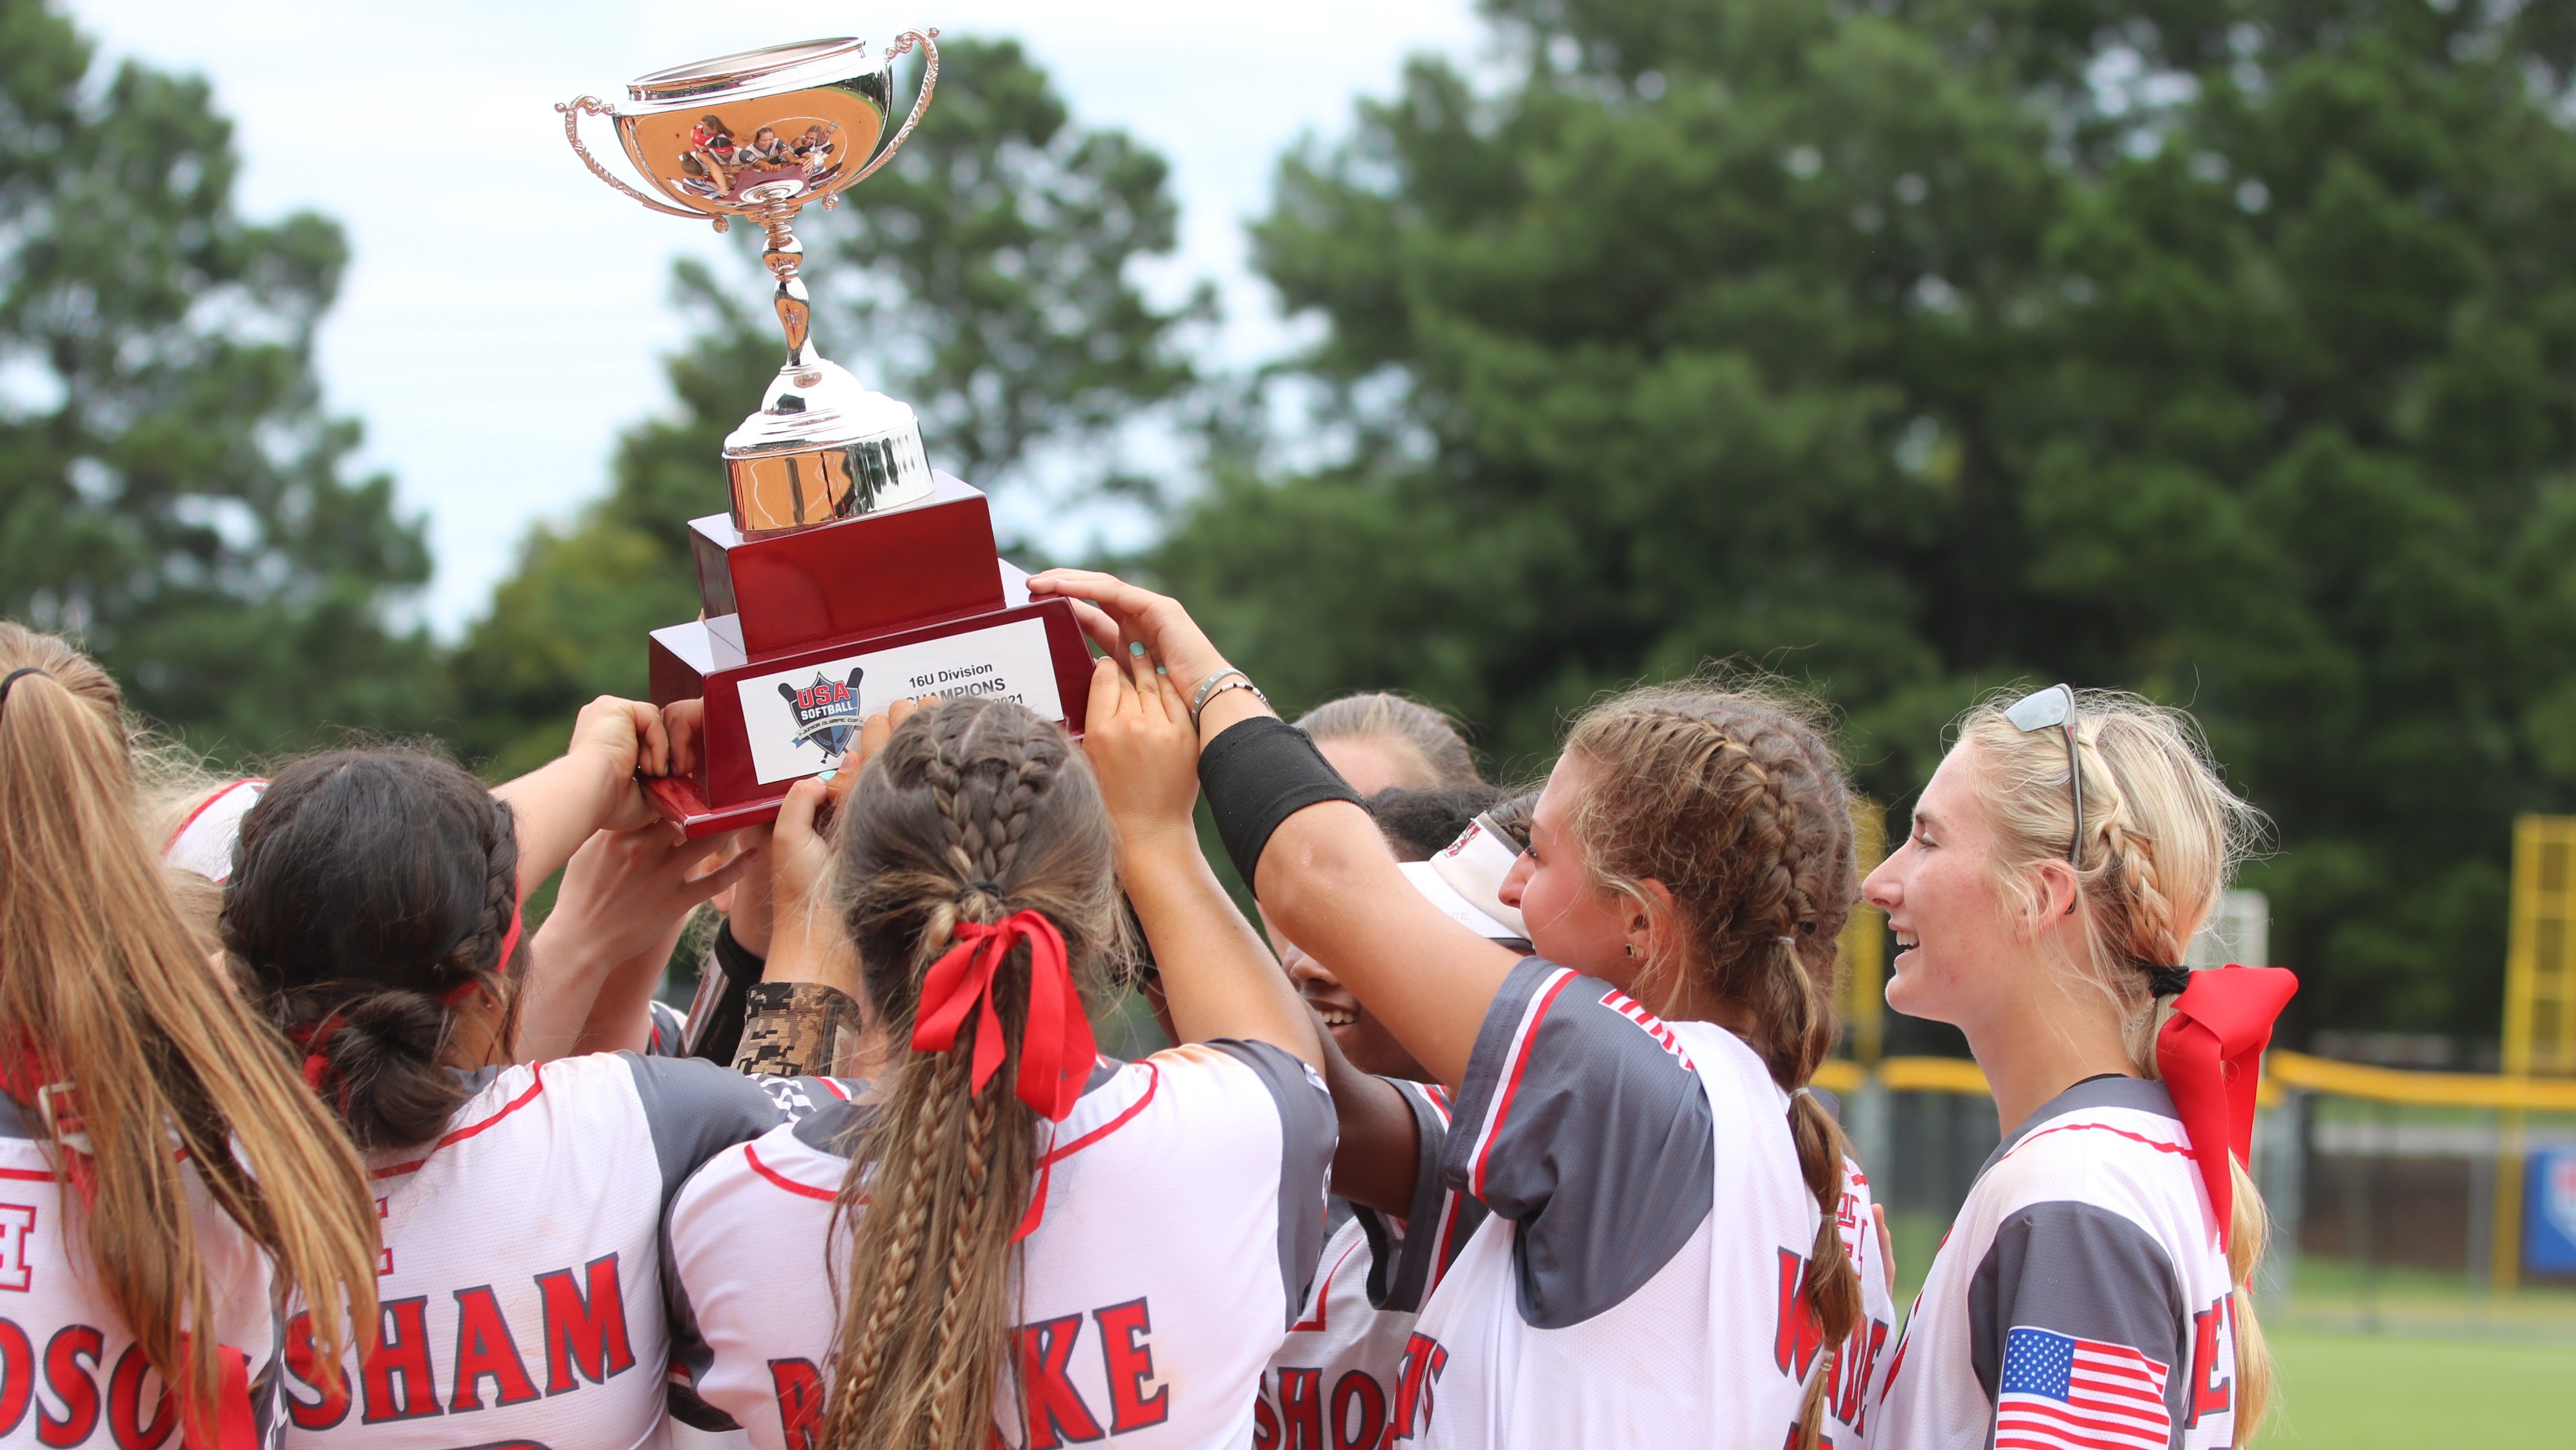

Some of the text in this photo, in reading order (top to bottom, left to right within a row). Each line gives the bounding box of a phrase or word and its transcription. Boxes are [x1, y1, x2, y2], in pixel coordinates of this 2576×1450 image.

[908, 663, 994, 688] 16U Division
[795, 681, 852, 710] USA
[800, 701, 854, 721] SOFTBALL
[802, 722, 821, 734] JUNIOR
